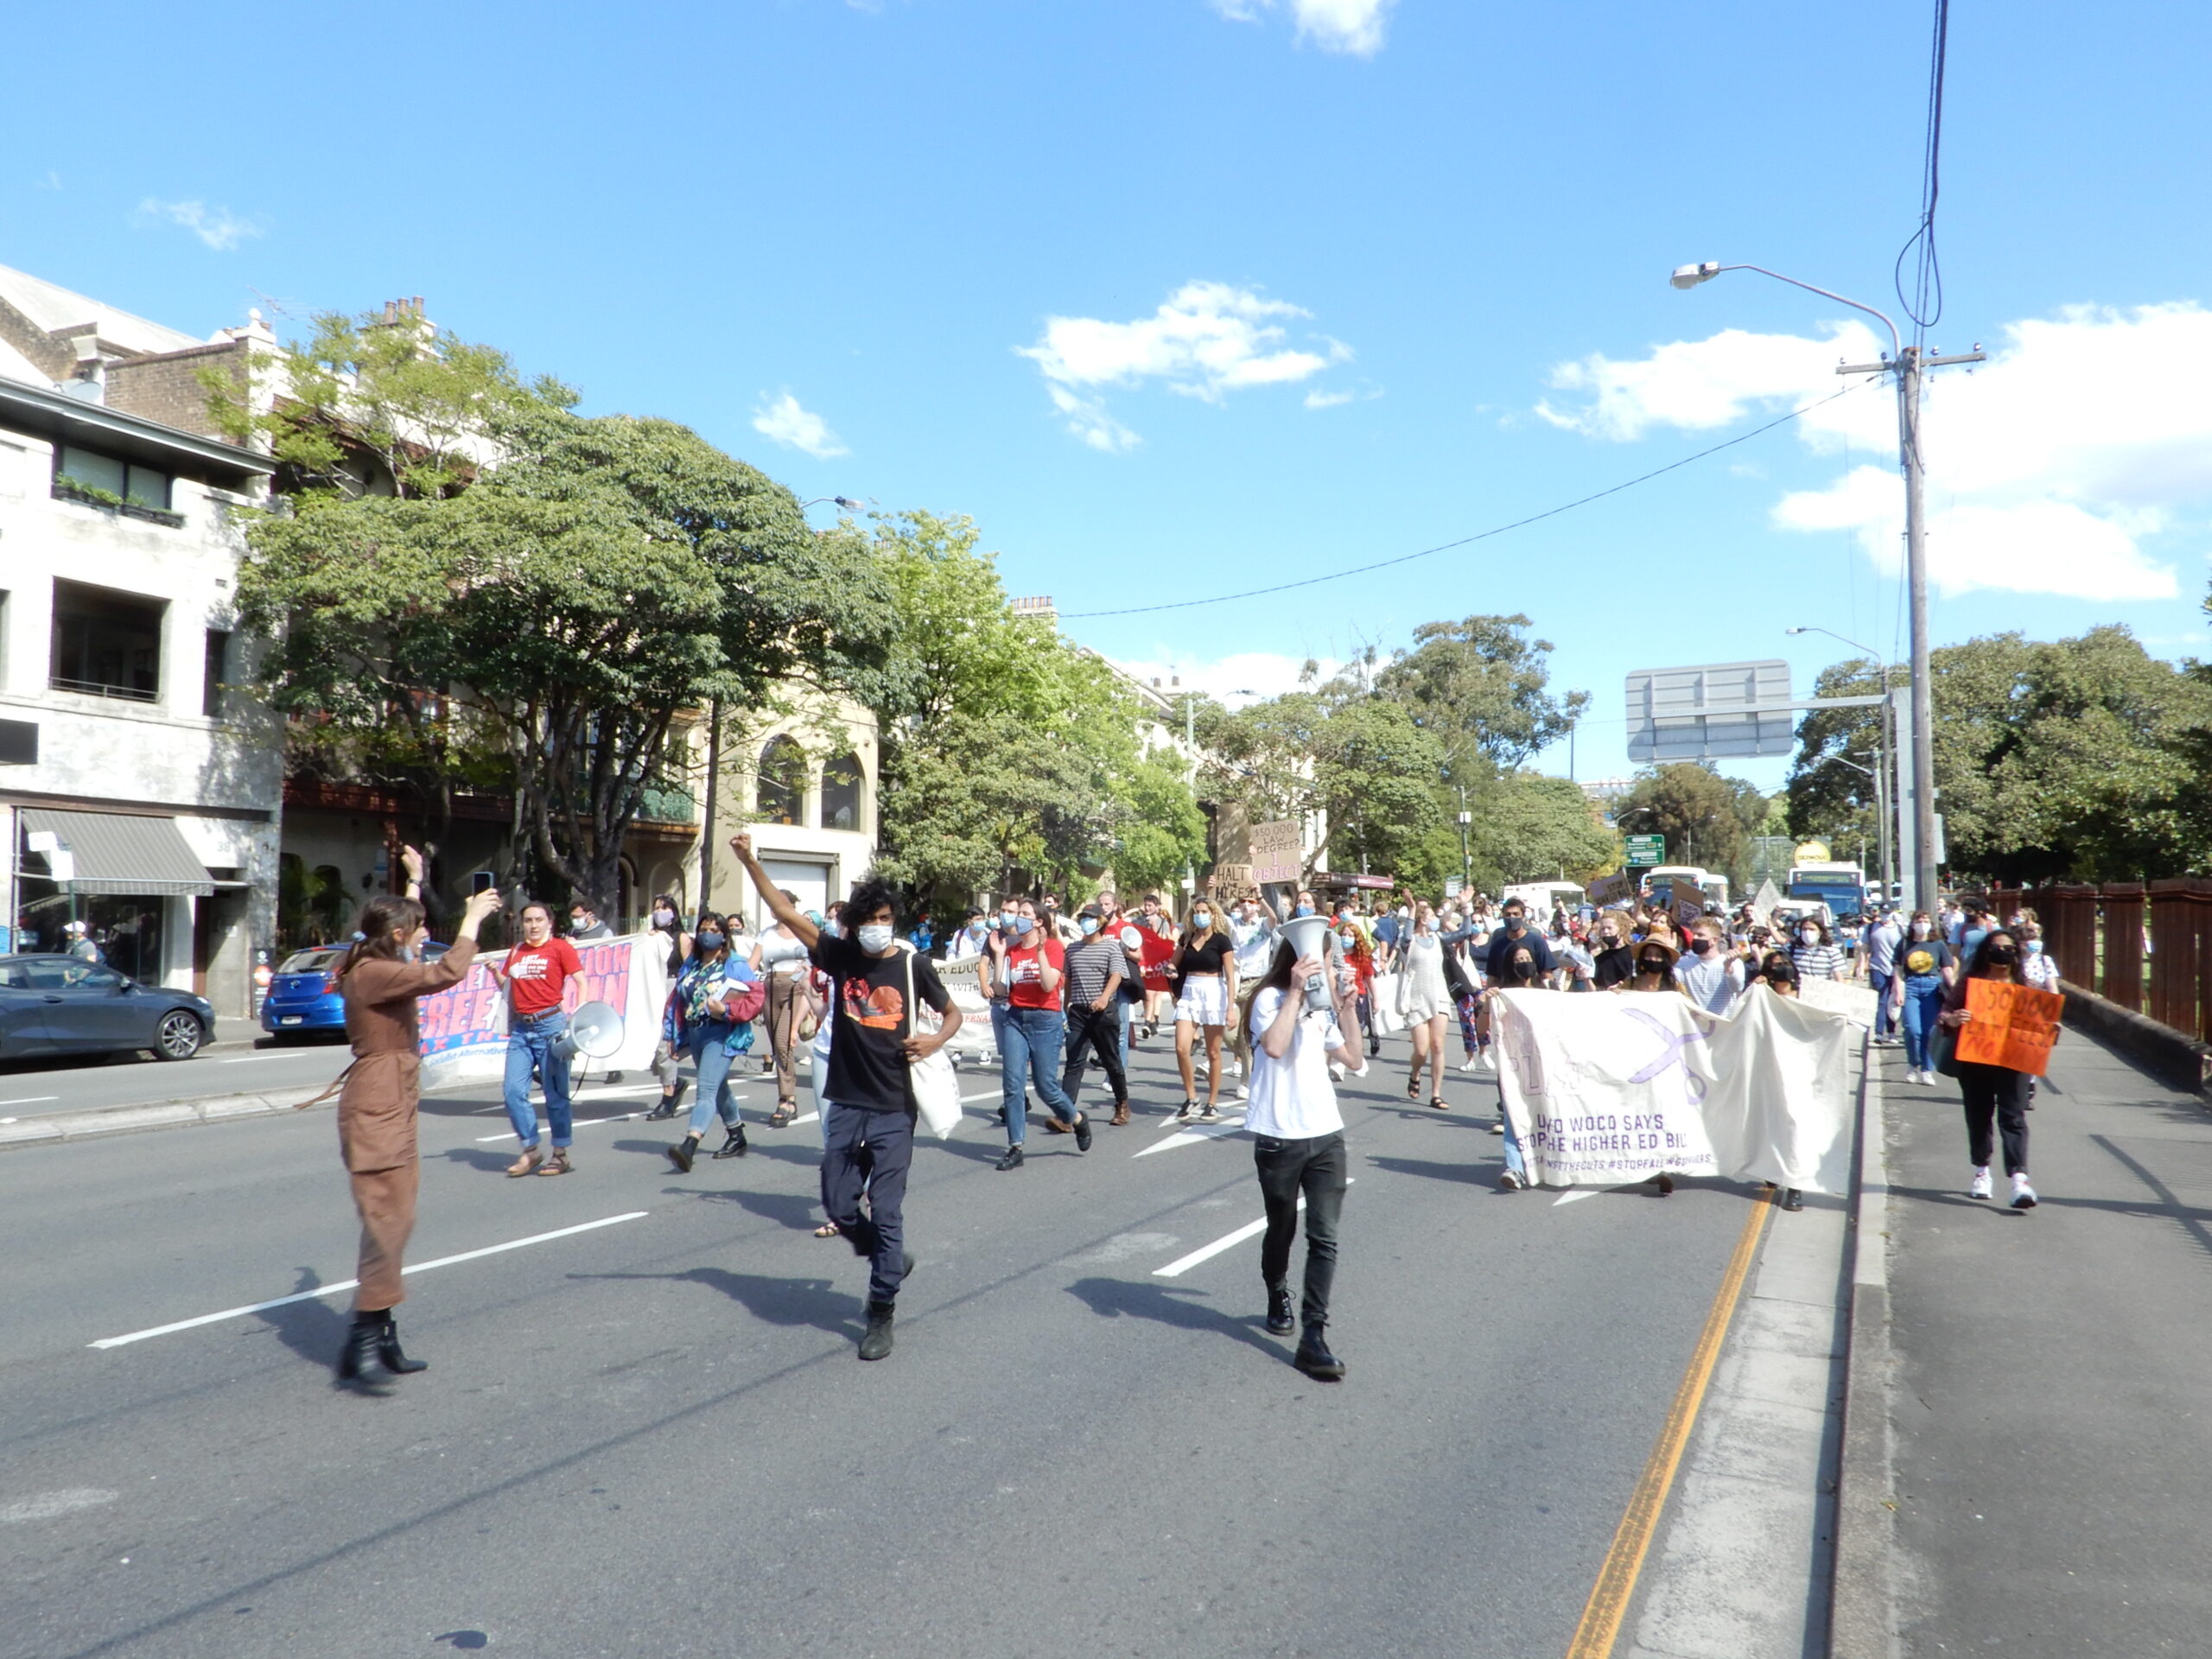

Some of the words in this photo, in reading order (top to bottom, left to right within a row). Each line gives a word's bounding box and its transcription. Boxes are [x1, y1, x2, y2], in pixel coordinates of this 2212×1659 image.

[217, 841, 232, 853] 38
[1257, 838, 1300, 855] DEGREE?
[1263, 835, 1285, 844] LAW
[1217, 867, 1249, 881] HALT
[1253, 865, 1300, 880] OBJECT
[419, 1038, 448, 1054] AX
[1624, 1114, 1663, 1131] SAYS
[1547, 1136, 1567, 1152] HE
[1573, 1135, 1631, 1152] HIGHER
[1639, 1133, 1658, 1149] ED
